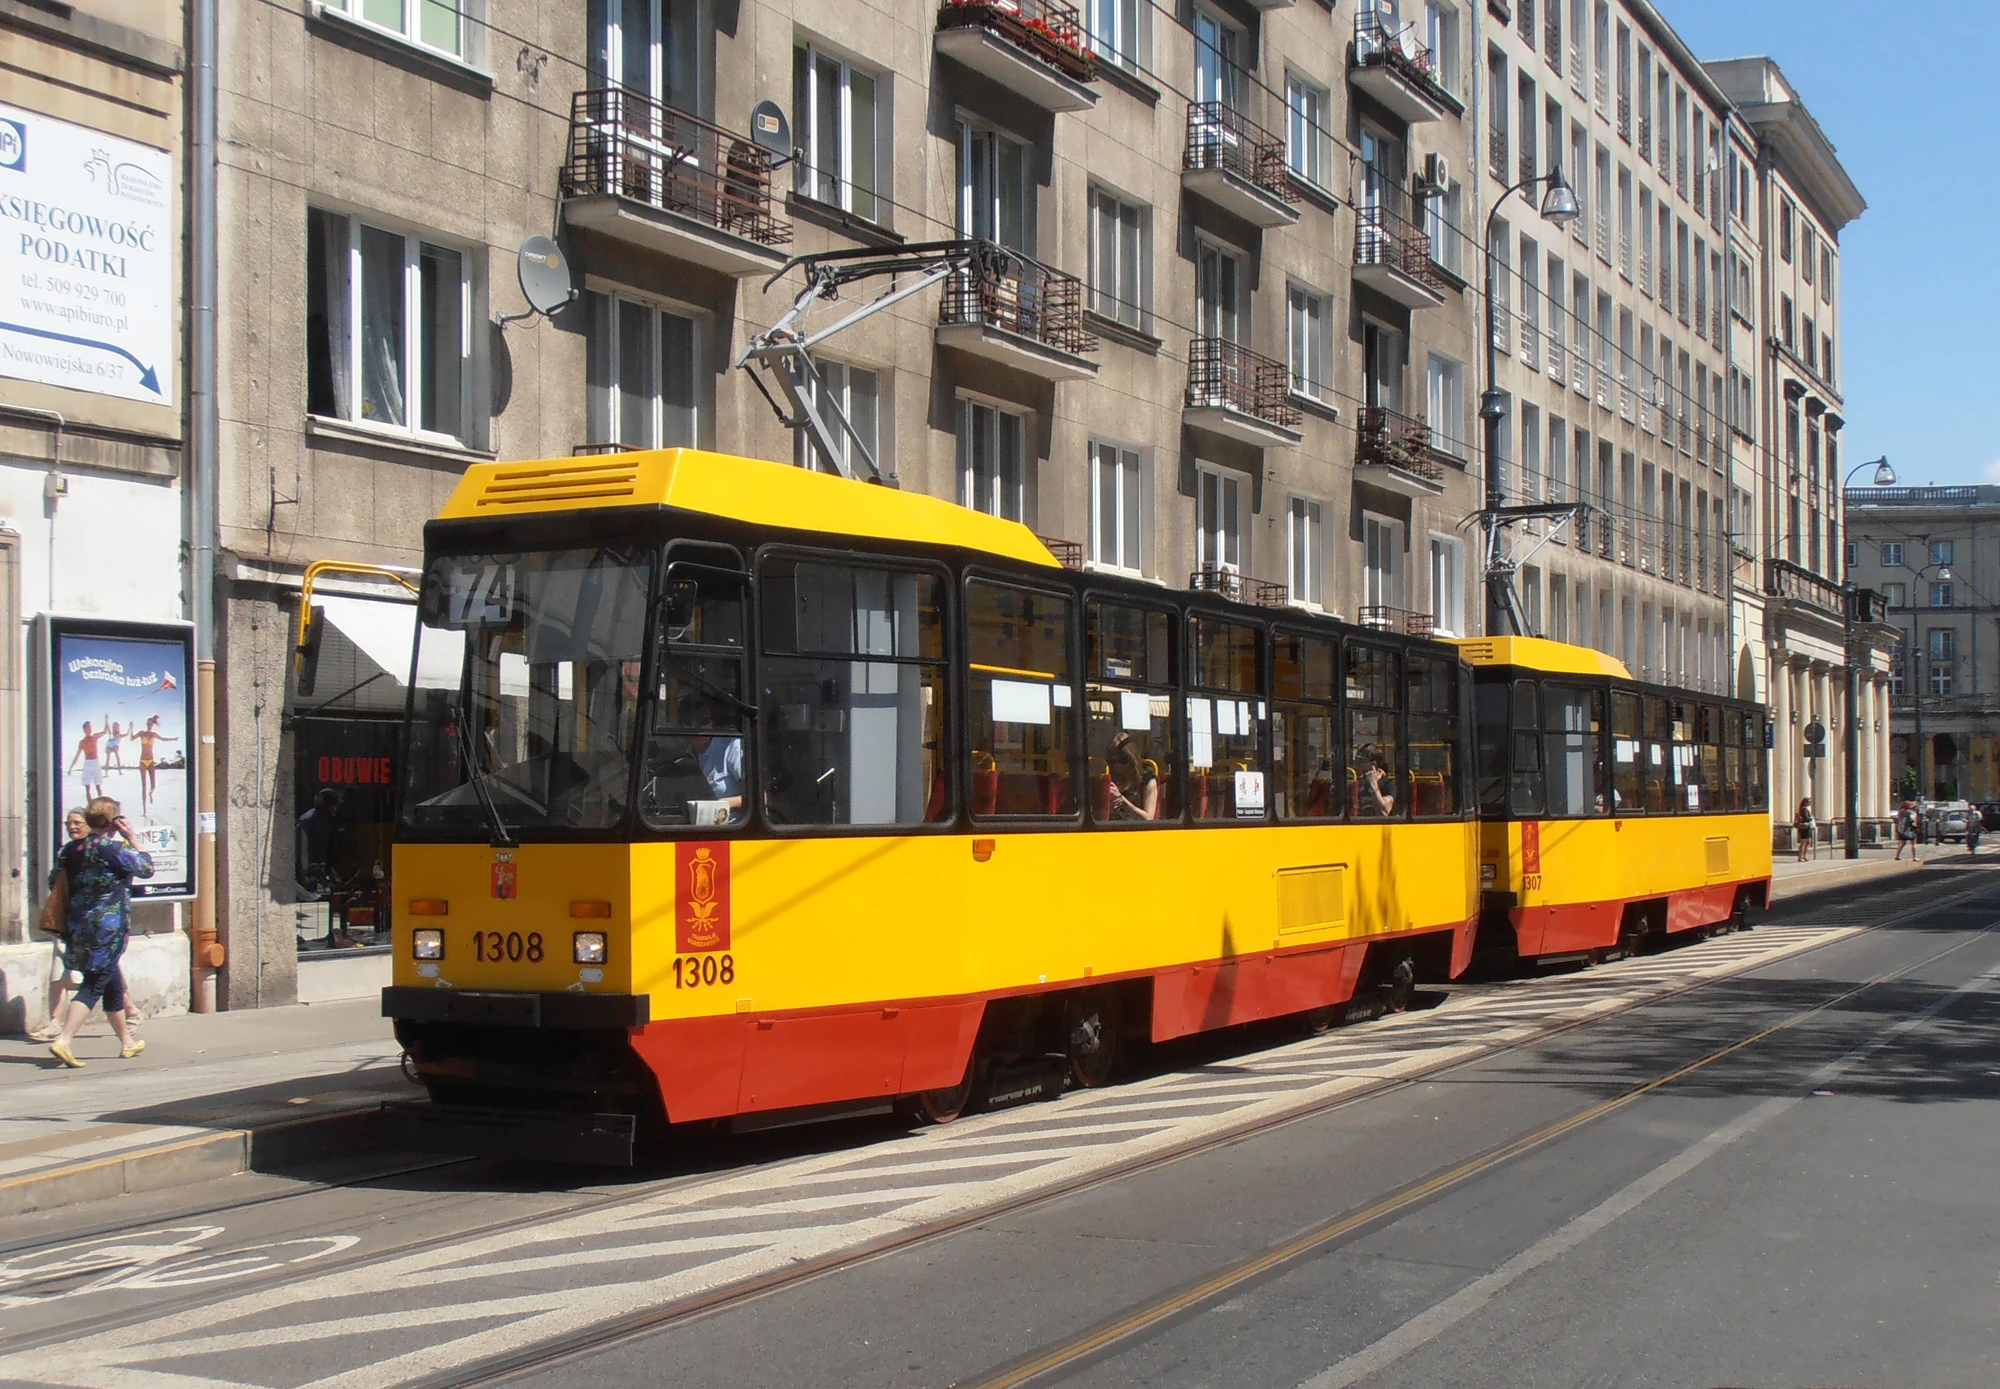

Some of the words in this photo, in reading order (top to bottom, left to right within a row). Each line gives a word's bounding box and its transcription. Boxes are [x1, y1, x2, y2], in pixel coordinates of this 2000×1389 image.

[0, 132, 17, 154] Pi
[20, 232, 128, 279] PODATKI
[22, 273, 42, 289] tel.
[46, 276, 71, 295] 509
[75, 282, 99, 301] 929
[103, 288, 126, 308] 700
[20, 297, 129, 333] www.apibiuro.pl
[2, 342, 93, 375] Nowowiejska
[96, 361, 124, 380] 6/37
[461, 564, 509, 619] 74
[318, 756, 392, 784] OBUWIE
[1522, 875, 1541, 891] 1307
[473, 931, 545, 963] 1308
[672, 954, 735, 989] 1308
